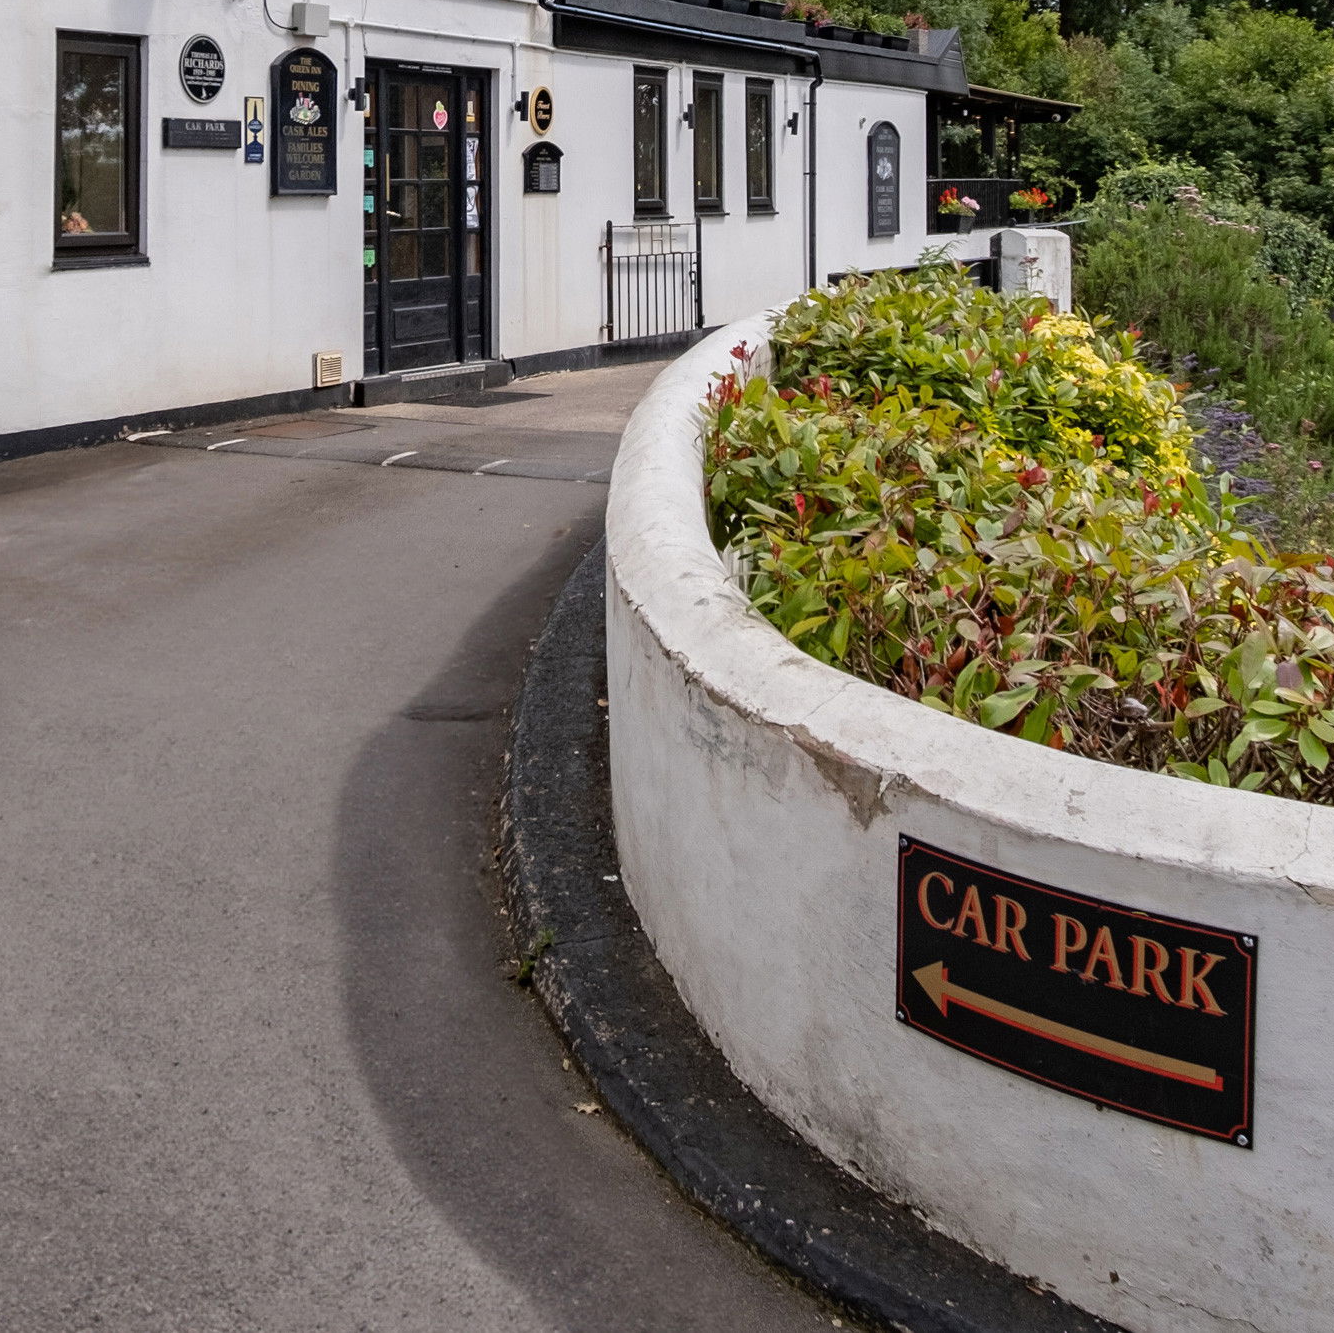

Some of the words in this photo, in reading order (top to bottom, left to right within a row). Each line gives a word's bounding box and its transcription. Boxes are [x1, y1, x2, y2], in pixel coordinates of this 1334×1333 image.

[184, 58, 224, 71] RICHARDS
[300, 57, 312, 66] THE
[289, 64, 310, 73] QUEEN
[292, 80, 319, 92] DINING
[205, 122, 226, 132] PARK
[282, 125, 305, 137] CASK
[307, 126, 328, 138] ALES
[287, 142, 323, 153] FAMILIES
[286, 153, 325, 164] WELCOME
[289, 170, 321, 181] GARDEN
[918, 871, 1032, 962] CAR
[1049, 912, 1228, 1017] PARK
